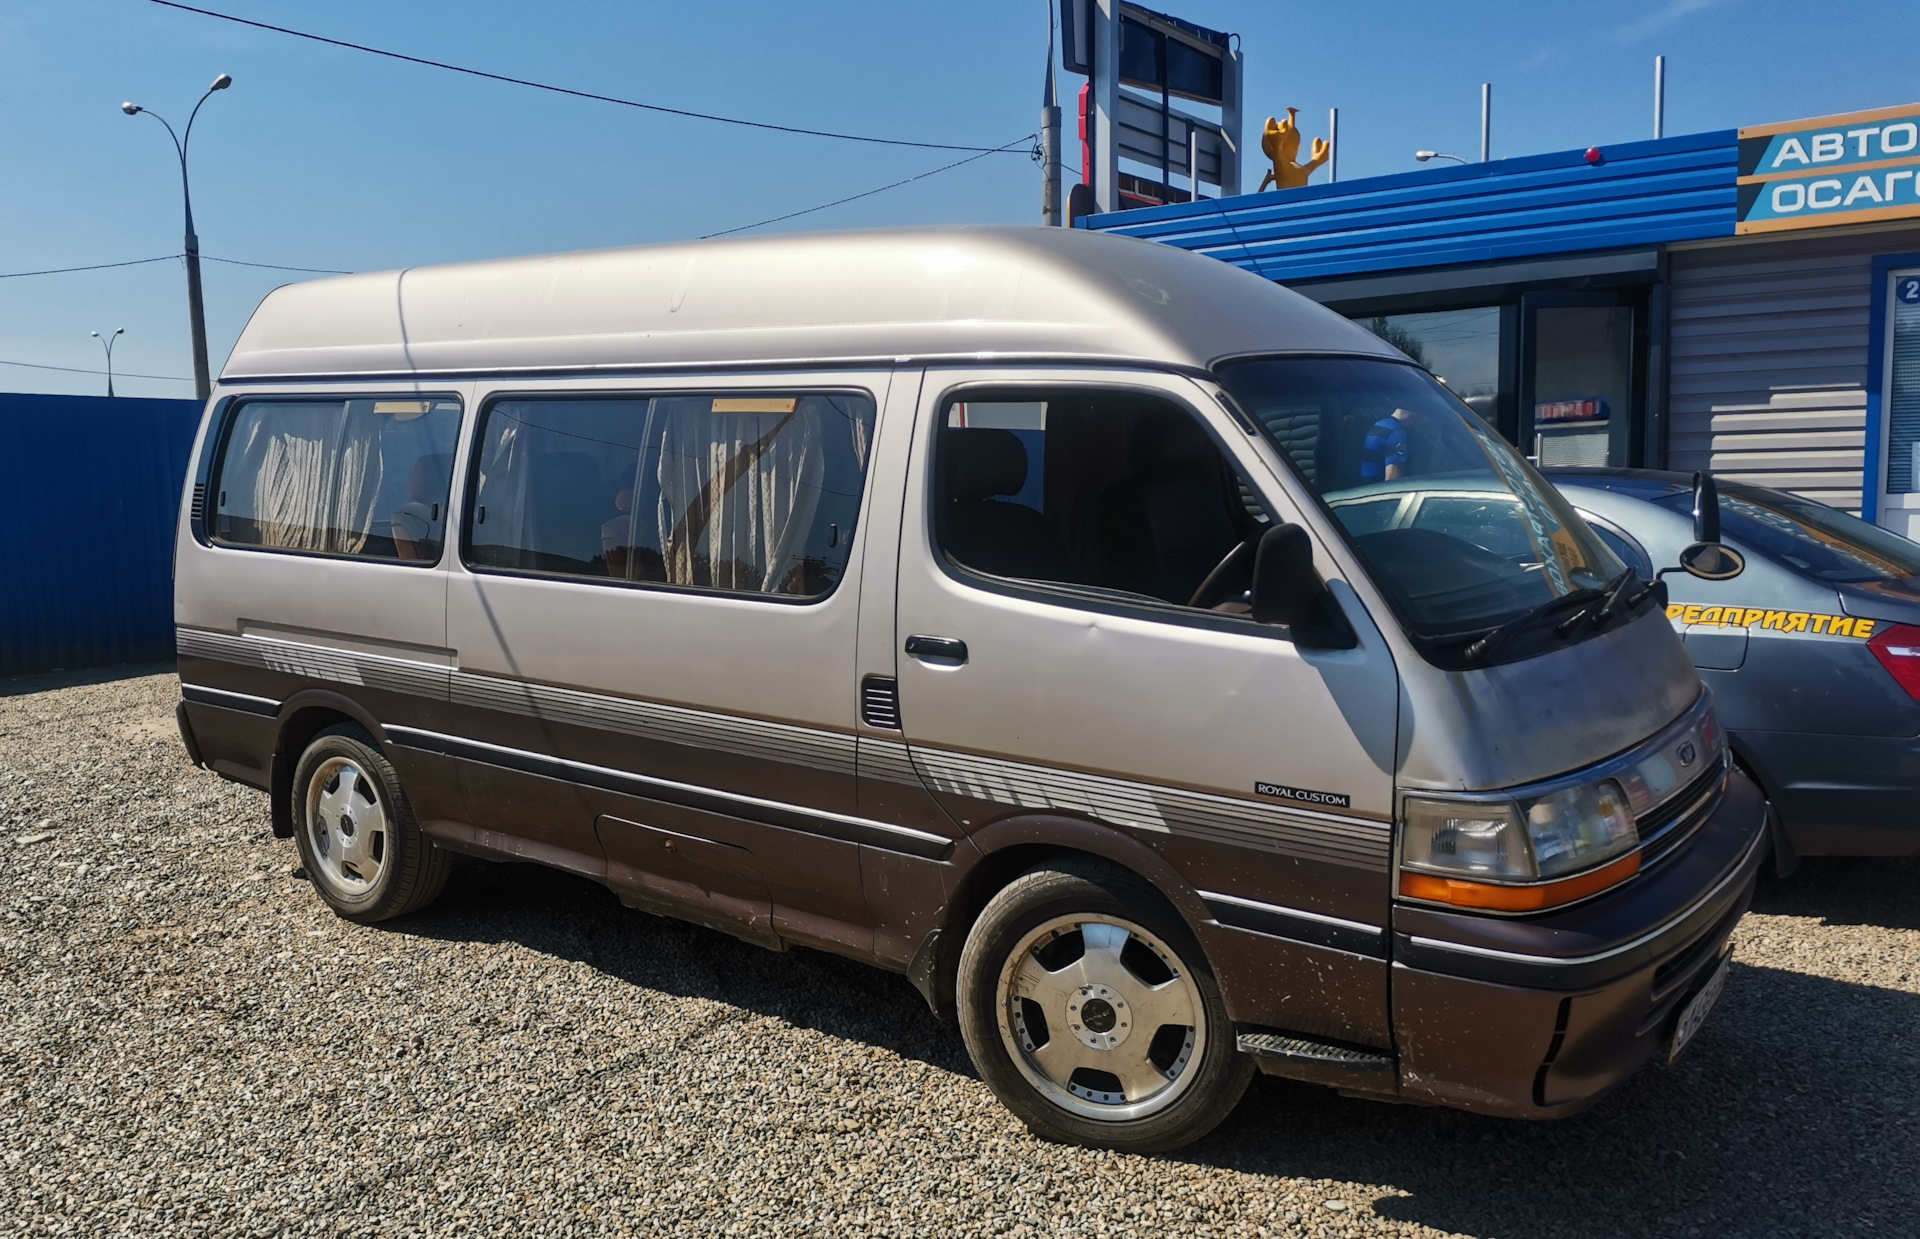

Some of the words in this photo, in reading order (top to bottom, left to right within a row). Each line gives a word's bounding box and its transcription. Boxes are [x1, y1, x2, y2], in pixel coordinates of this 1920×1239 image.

[1771, 122, 1918, 168] АВТО
[1771, 170, 1920, 213] ОСАГ
[1258, 784, 1295, 798] ROYAL
[1296, 790, 1346, 806] CUSTOM
